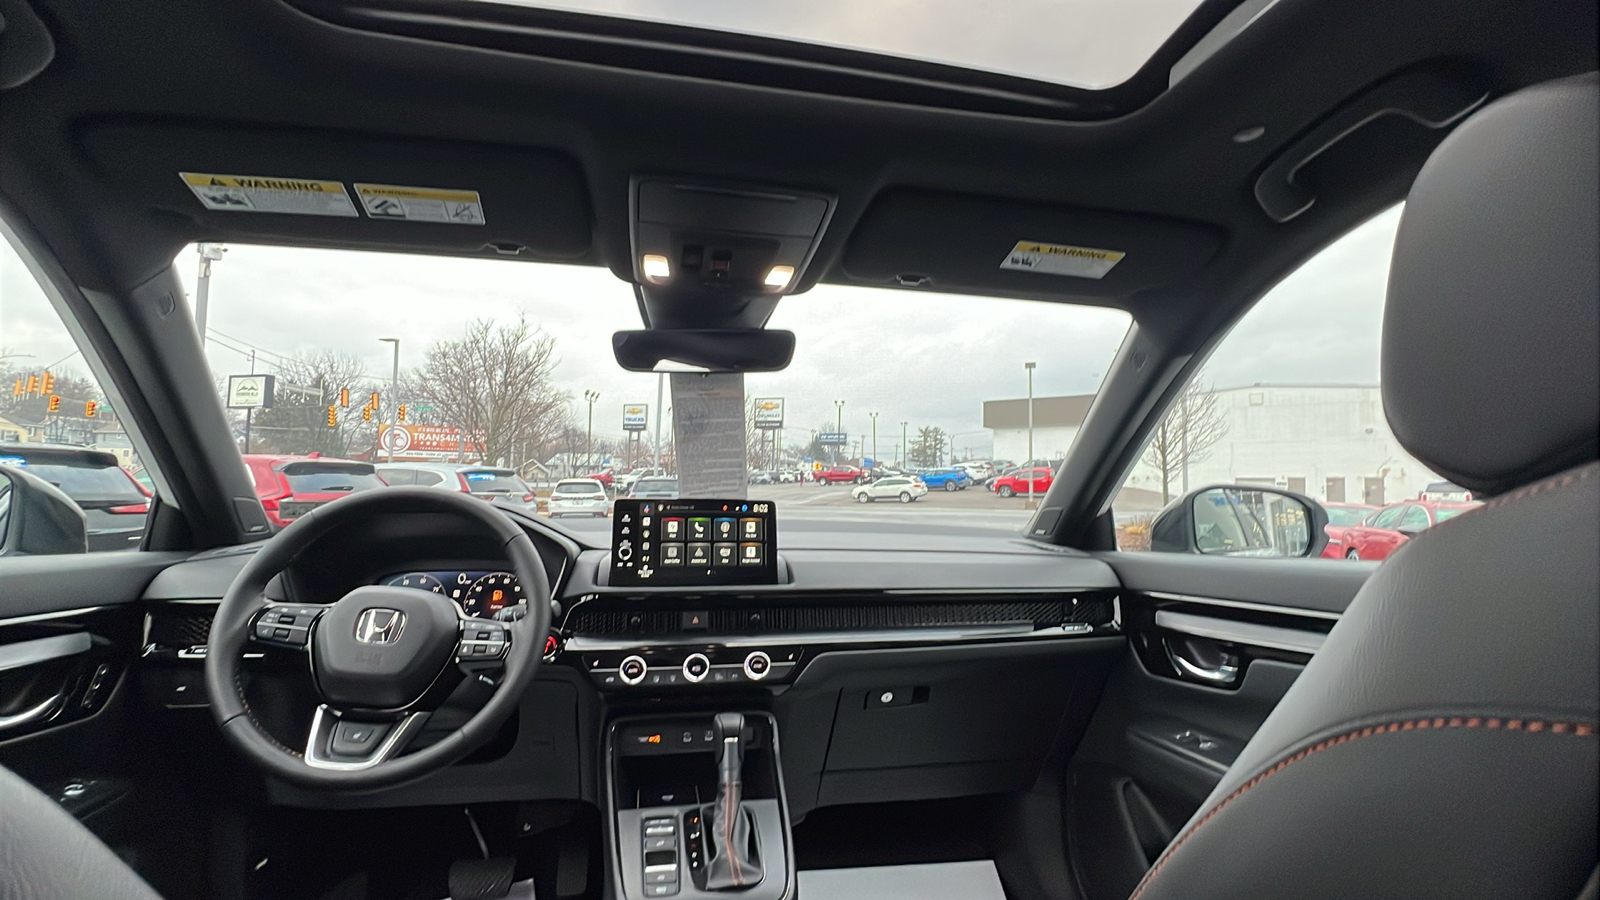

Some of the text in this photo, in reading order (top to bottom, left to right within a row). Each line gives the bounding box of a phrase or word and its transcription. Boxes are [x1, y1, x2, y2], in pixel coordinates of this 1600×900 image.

[234, 177, 324, 193] WARNING
[1048, 245, 1108, 259] WARNING
[413, 432, 487, 443] TRANS4MTION
[753, 503, 769, 513] 8:02
